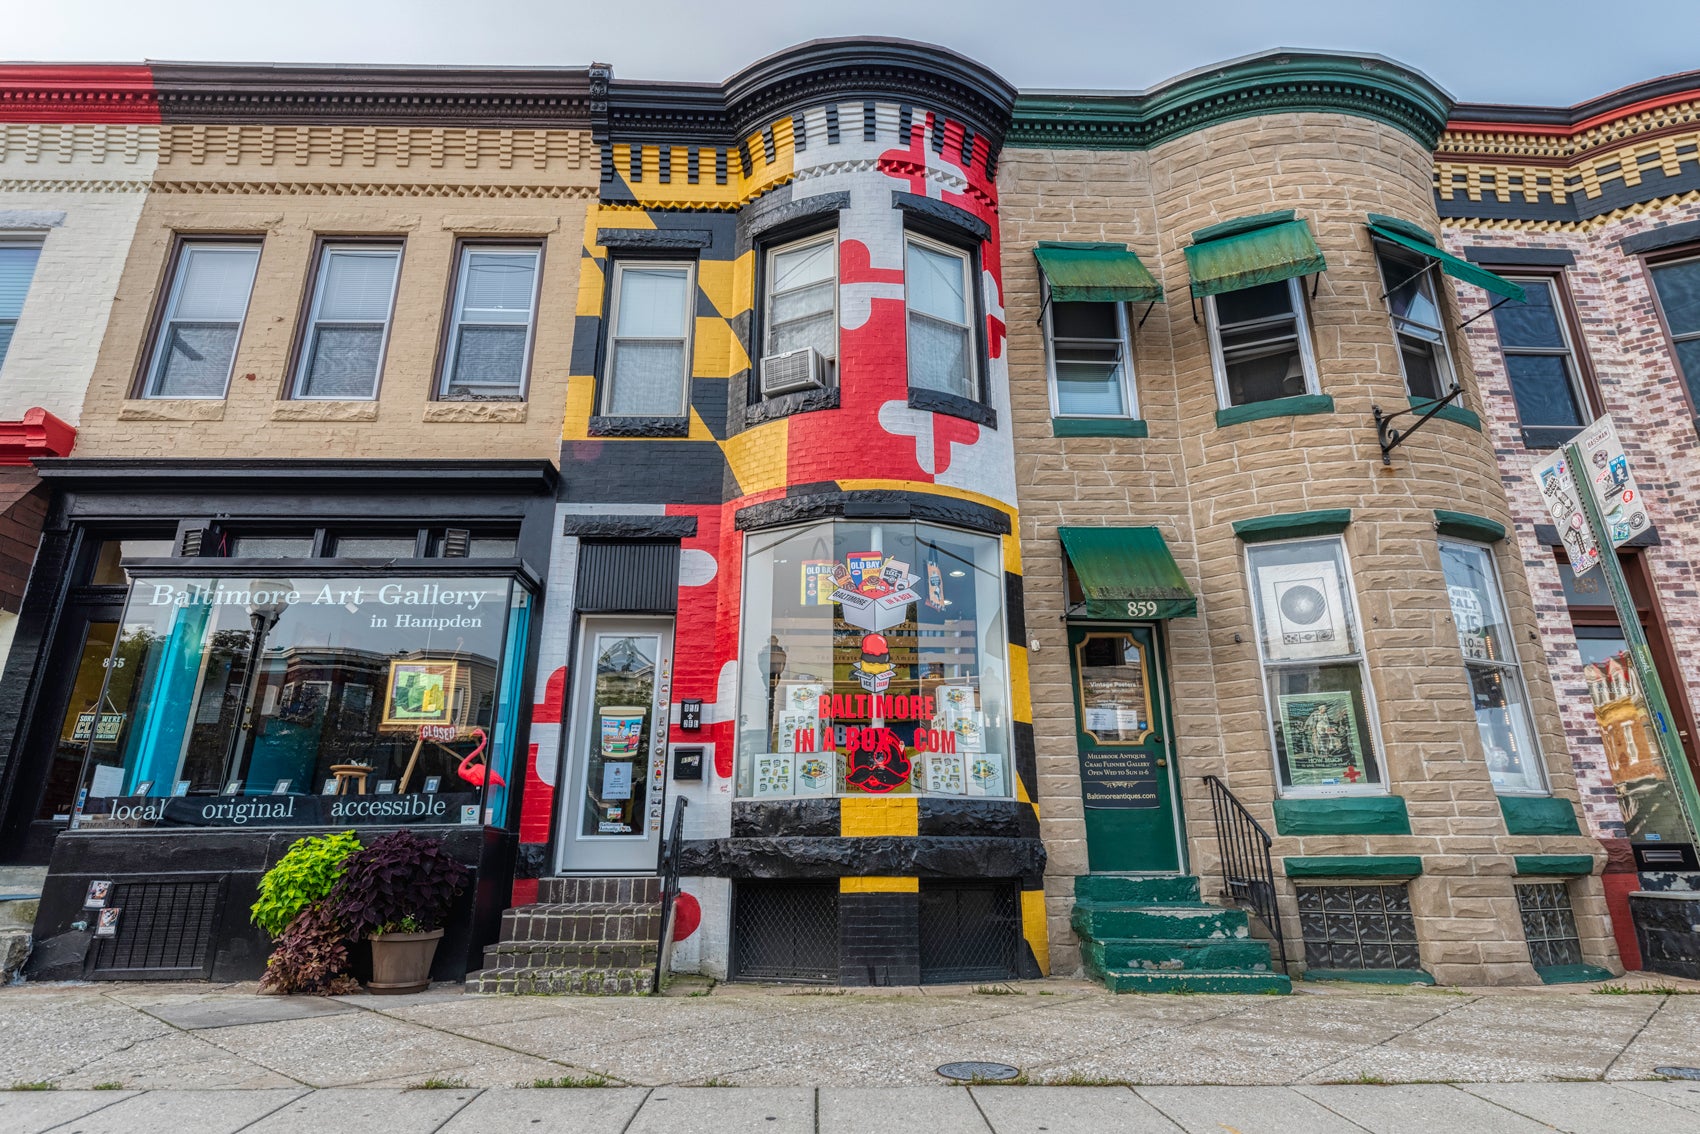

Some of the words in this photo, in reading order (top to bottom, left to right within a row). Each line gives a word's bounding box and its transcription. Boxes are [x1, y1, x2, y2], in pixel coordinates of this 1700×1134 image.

[806, 566, 821, 574] OLD
[850, 561, 864, 570] OLD
[865, 560, 881, 569] BAY
[149, 584, 300, 606] Baltimore
[312, 583, 364, 605] Art
[378, 583, 487, 611] Gallery
[832, 590, 868, 606] BALTIMORE
[899, 593, 913, 602] BOX
[1127, 601, 1158, 617] 859
[369, 614, 388, 628] in
[394, 614, 482, 631] Hampden
[818, 694, 934, 720] BALTIMORE
[75, 722, 120, 734] CLSED
[422, 725, 455, 740] CLOSED
[795, 728, 815, 753] IN
[822, 727, 836, 751] A
[845, 727, 891, 752] BOX
[914, 727, 956, 754] COM
[108, 798, 165, 821] local
[202, 797, 294, 824] original
[331, 795, 446, 818] accessible
